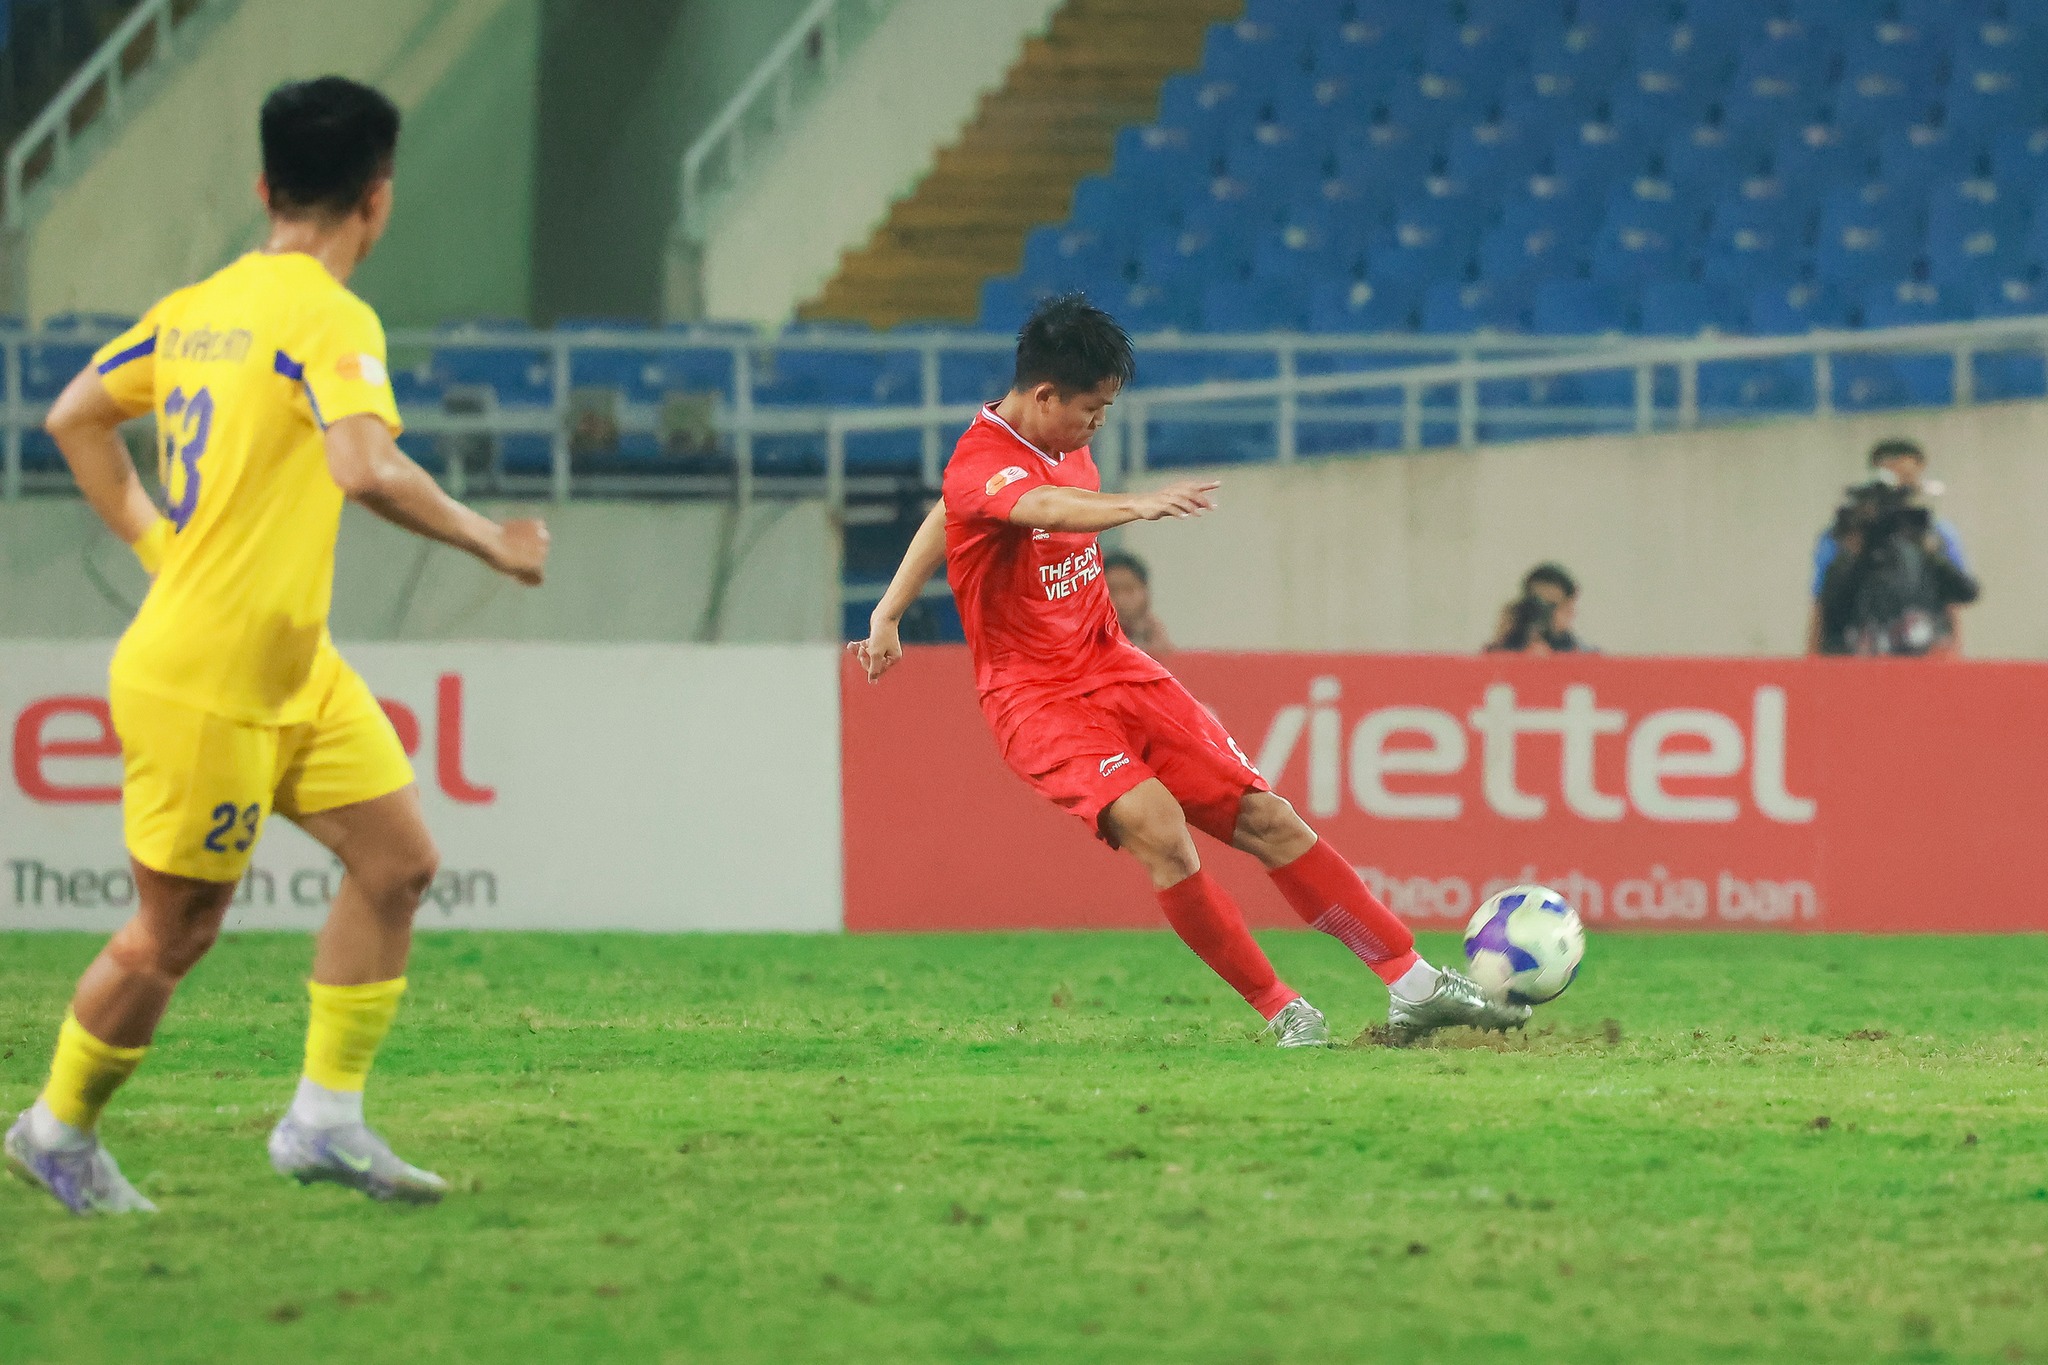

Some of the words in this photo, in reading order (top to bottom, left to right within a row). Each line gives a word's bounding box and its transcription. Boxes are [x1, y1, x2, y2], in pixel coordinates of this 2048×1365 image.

[1039, 552, 1075, 583] THẾ
[1045, 560, 1102, 601] VIETTEL
[204, 801, 260, 853] 23
[8, 857, 135, 907] Theo
